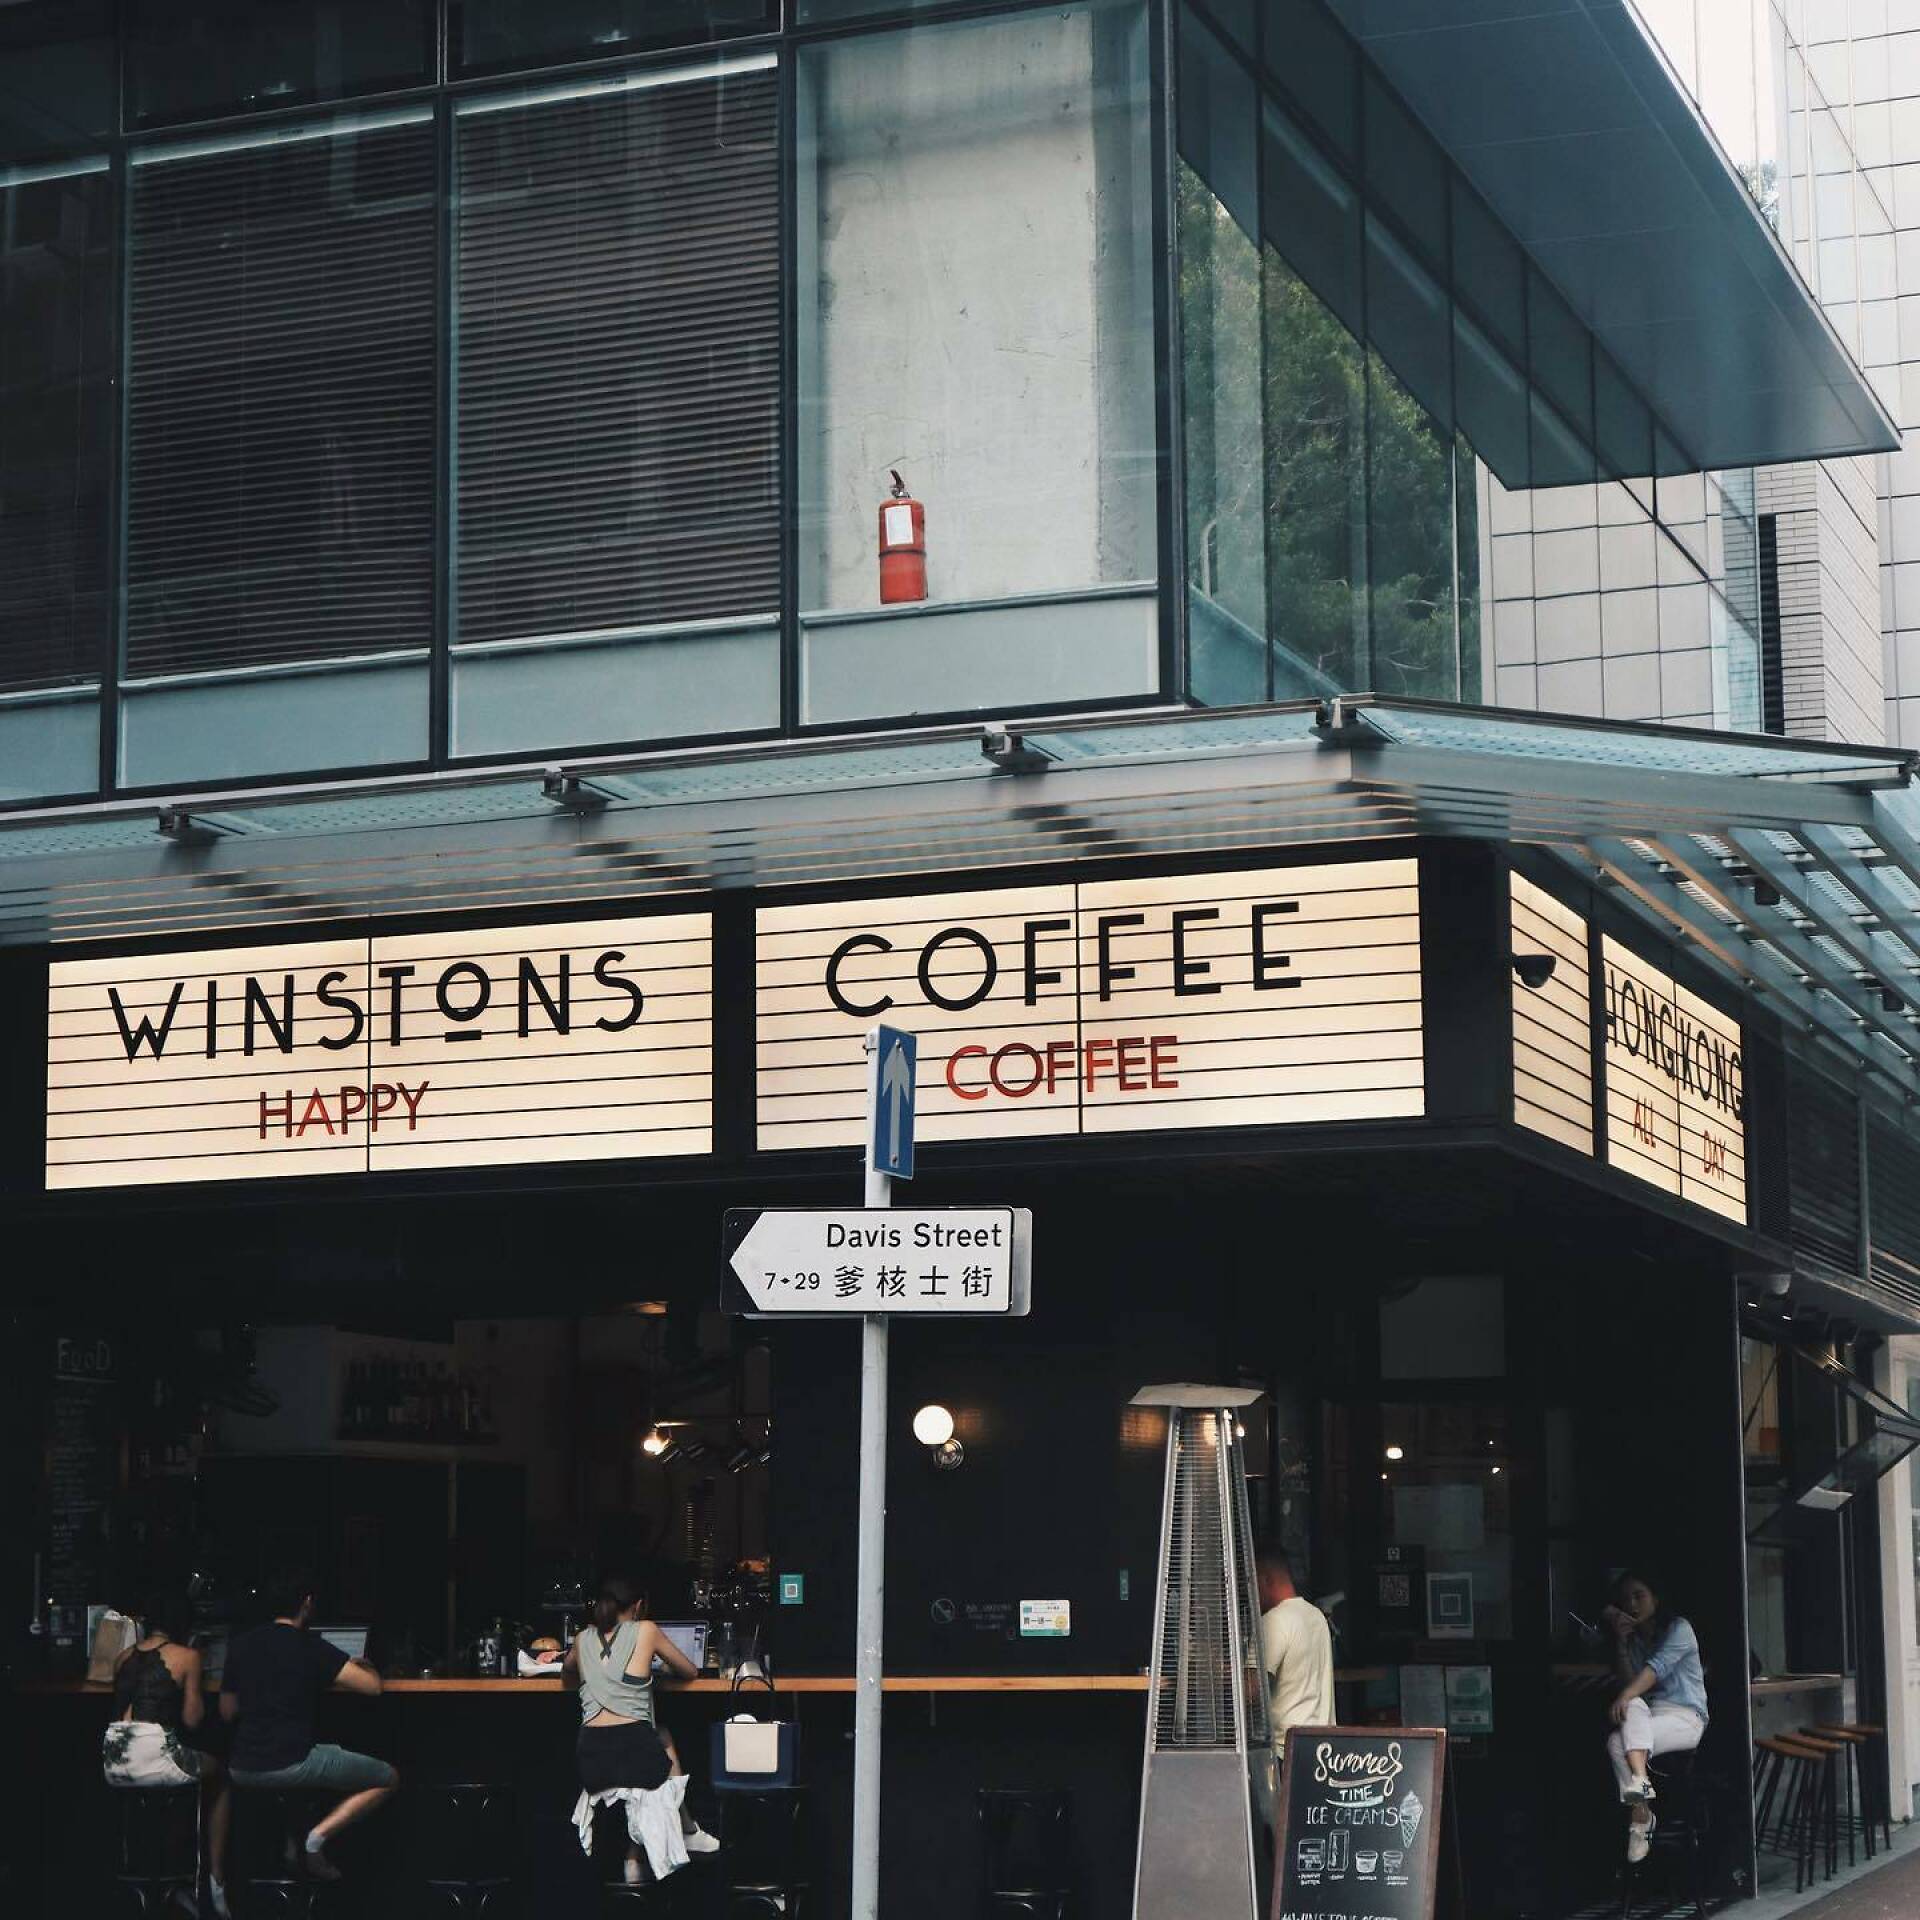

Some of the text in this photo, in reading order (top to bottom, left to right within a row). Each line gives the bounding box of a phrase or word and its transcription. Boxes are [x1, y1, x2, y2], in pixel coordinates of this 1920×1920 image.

[826, 901, 1302, 1018] COFFEE
[107, 950, 644, 1064] WINSTONS
[946, 1035, 1180, 1101] COFFEE
[259, 1081, 430, 1140] HAPPY
[1633, 1096, 1726, 1181] ALL DAY
[827, 1223, 1002, 1248] Davis Street
[834, 1265, 993, 1299] 爹核士街
[1305, 1806, 1399, 1828] ICE CREAMS
[1339, 1786, 1373, 1801] TIME
